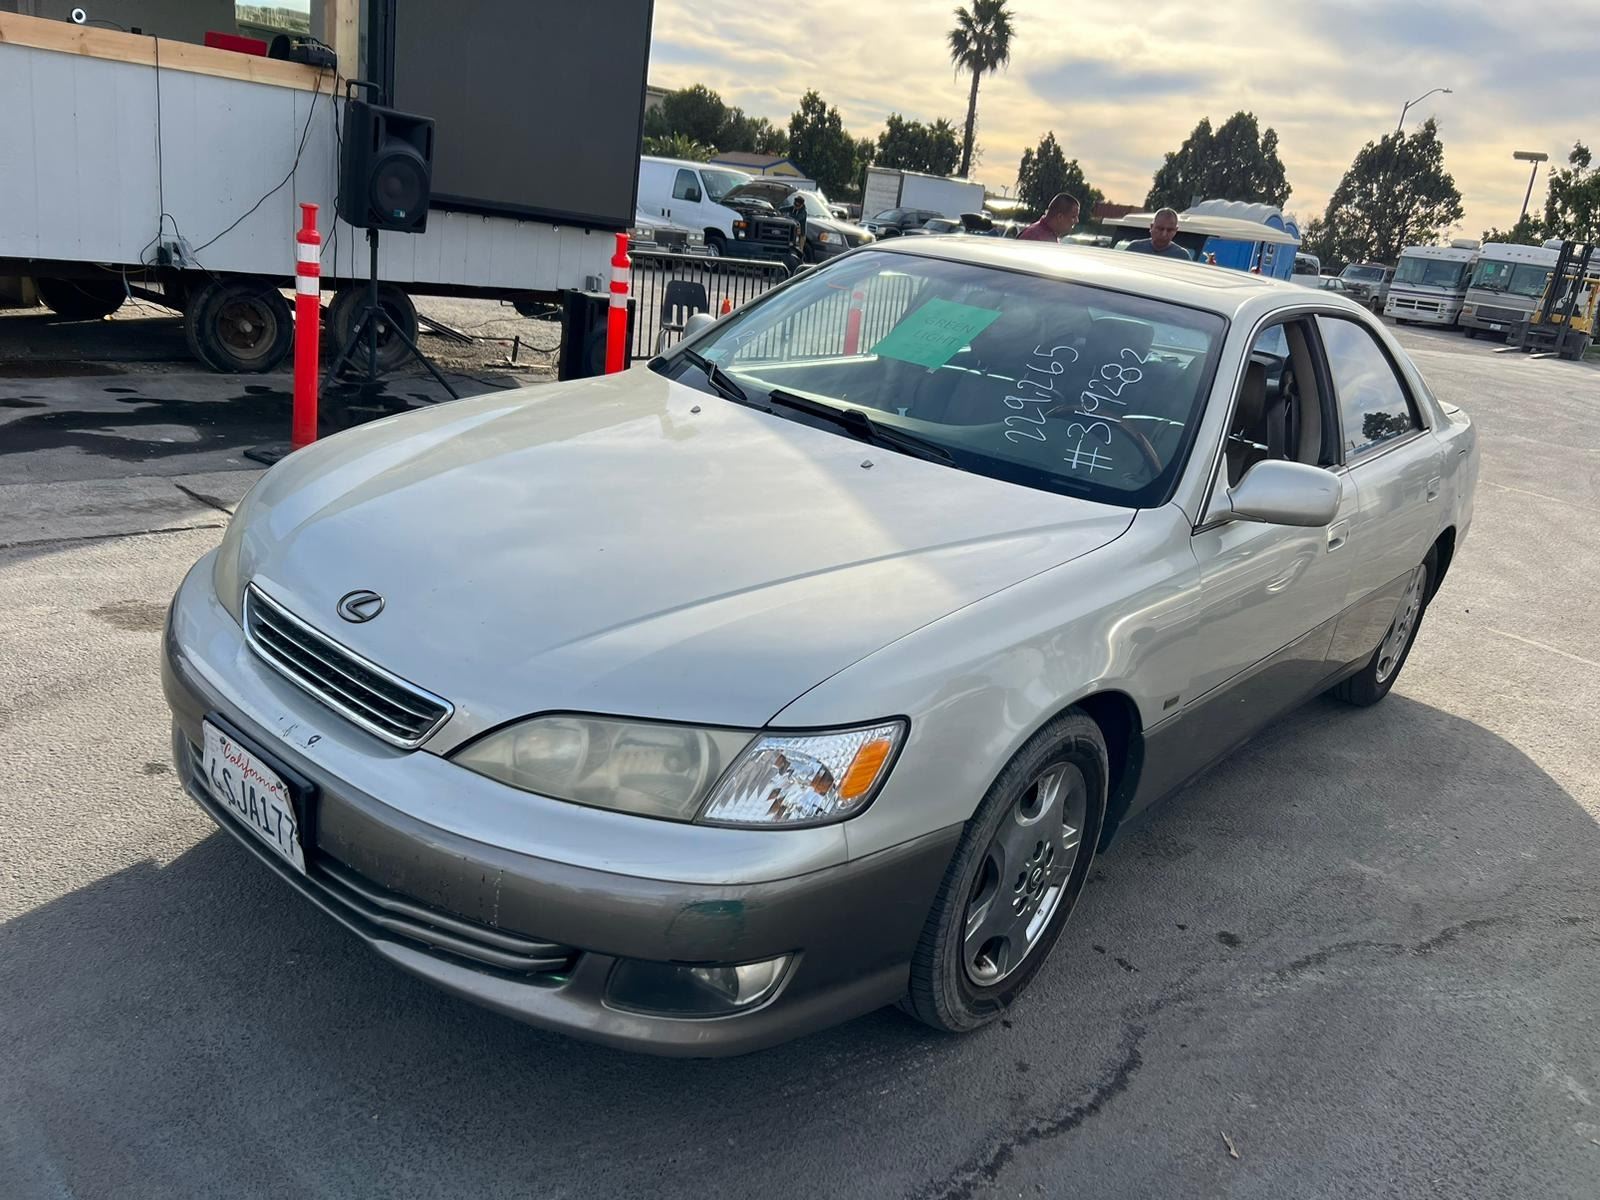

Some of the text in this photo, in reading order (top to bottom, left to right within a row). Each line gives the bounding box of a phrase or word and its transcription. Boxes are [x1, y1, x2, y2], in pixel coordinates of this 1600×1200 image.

[924, 317, 976, 334] GREEN
[913, 329, 961, 346] LIGHT
[223, 743, 280, 797] California
